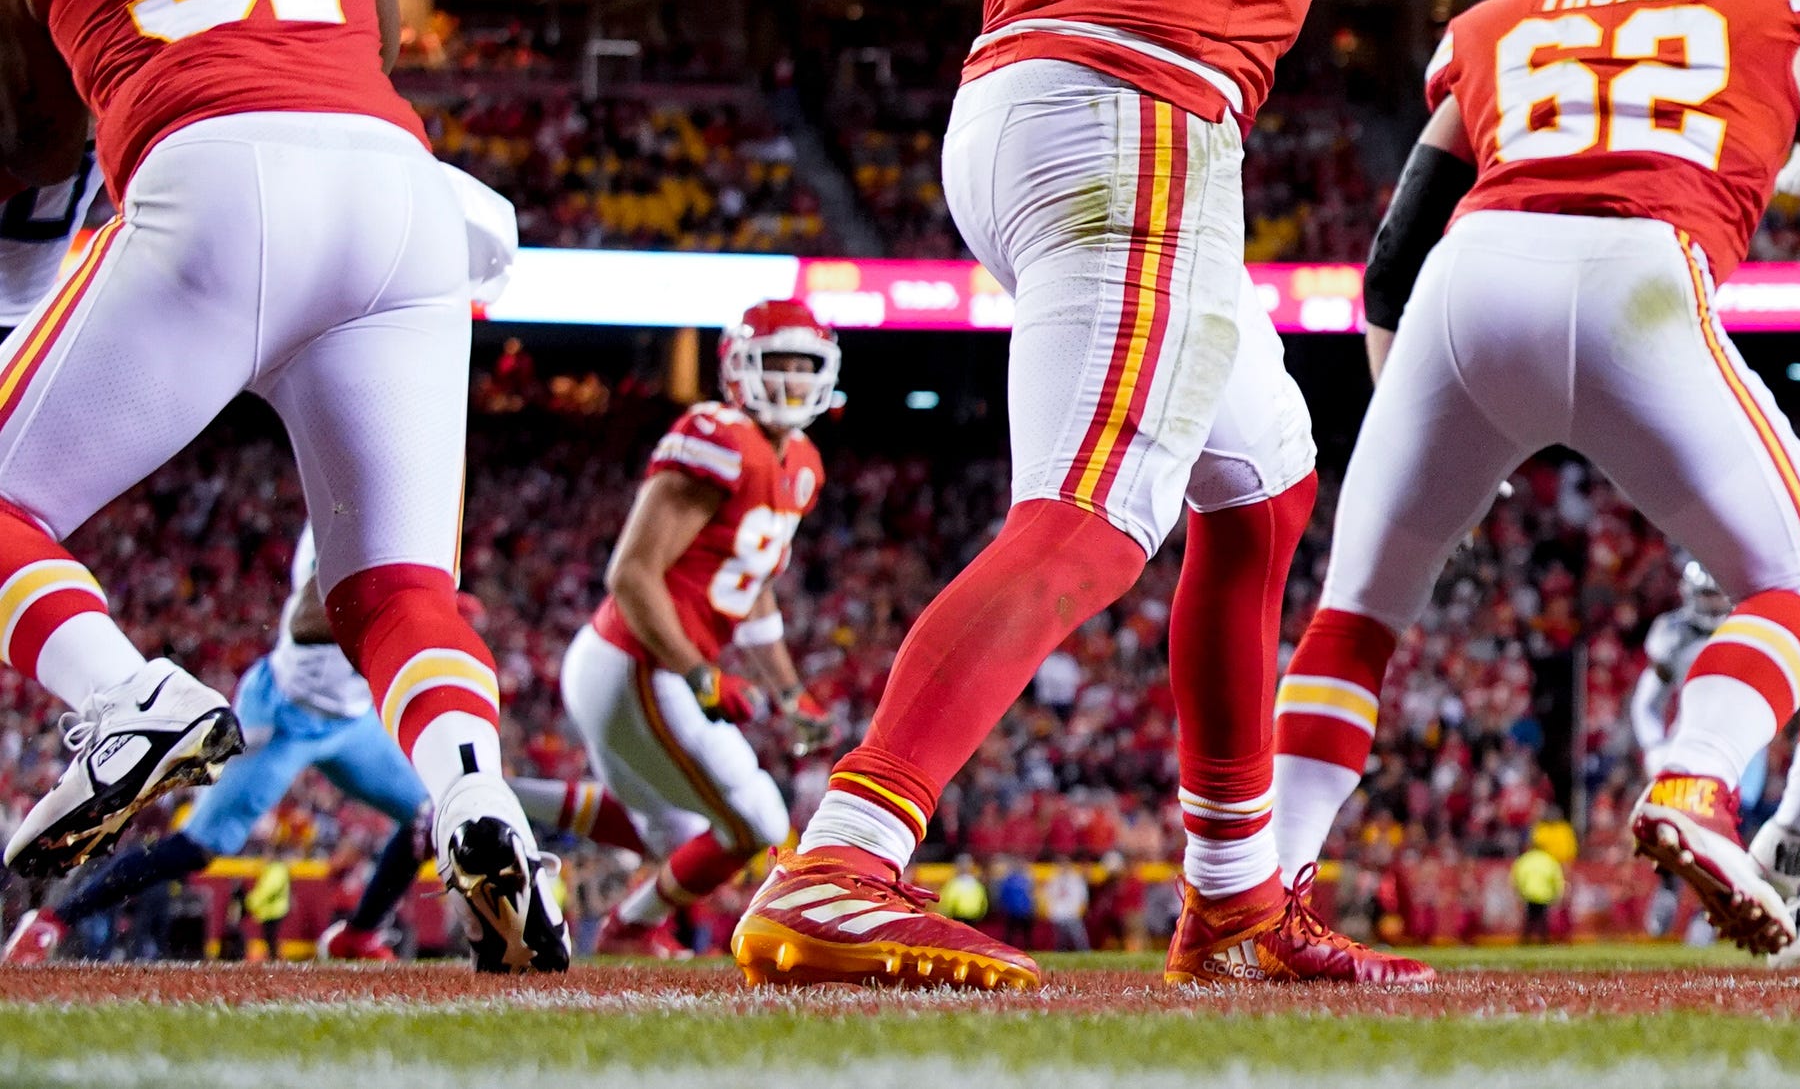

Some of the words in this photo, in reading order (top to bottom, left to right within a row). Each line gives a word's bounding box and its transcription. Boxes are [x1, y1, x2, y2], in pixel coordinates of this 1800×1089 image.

[1495, 4, 1729, 172] 62
[1651, 776, 1719, 819] NIKE
[1203, 959, 1266, 981] adidas
